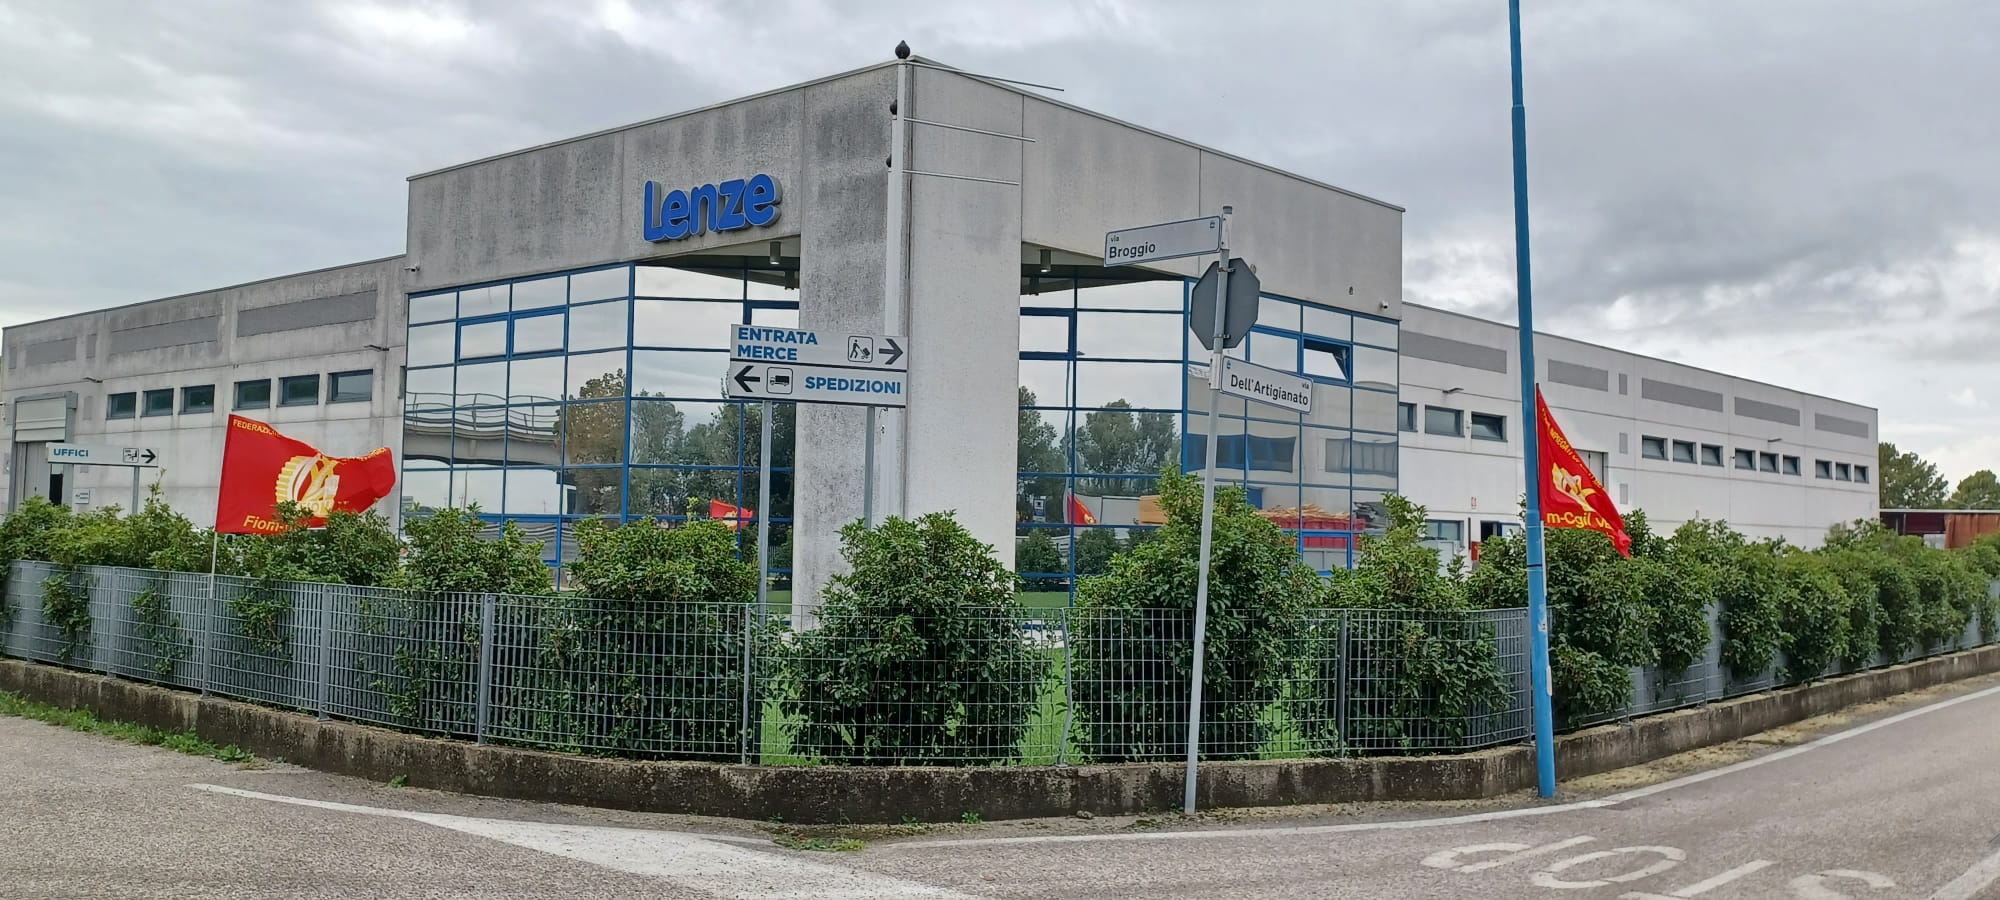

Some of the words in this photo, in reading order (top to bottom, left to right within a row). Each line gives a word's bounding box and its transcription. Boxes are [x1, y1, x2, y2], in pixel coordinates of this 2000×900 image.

[643, 173, 777, 242] Lenze
[1110, 235, 1120, 243] via
[1109, 241, 1156, 259] Broggio
[738, 327, 818, 345] ENTRATA
[737, 344, 798, 361] MERCE
[805, 376, 901, 394] SPEDIZIONI
[1230, 374, 1309, 406] Dell'Artigianato
[1302, 381, 1310, 390] via
[53, 448, 89, 457] UFFICI
[243, 515, 291, 533] Fiom-
[1547, 511, 1592, 528] m-Cgil
